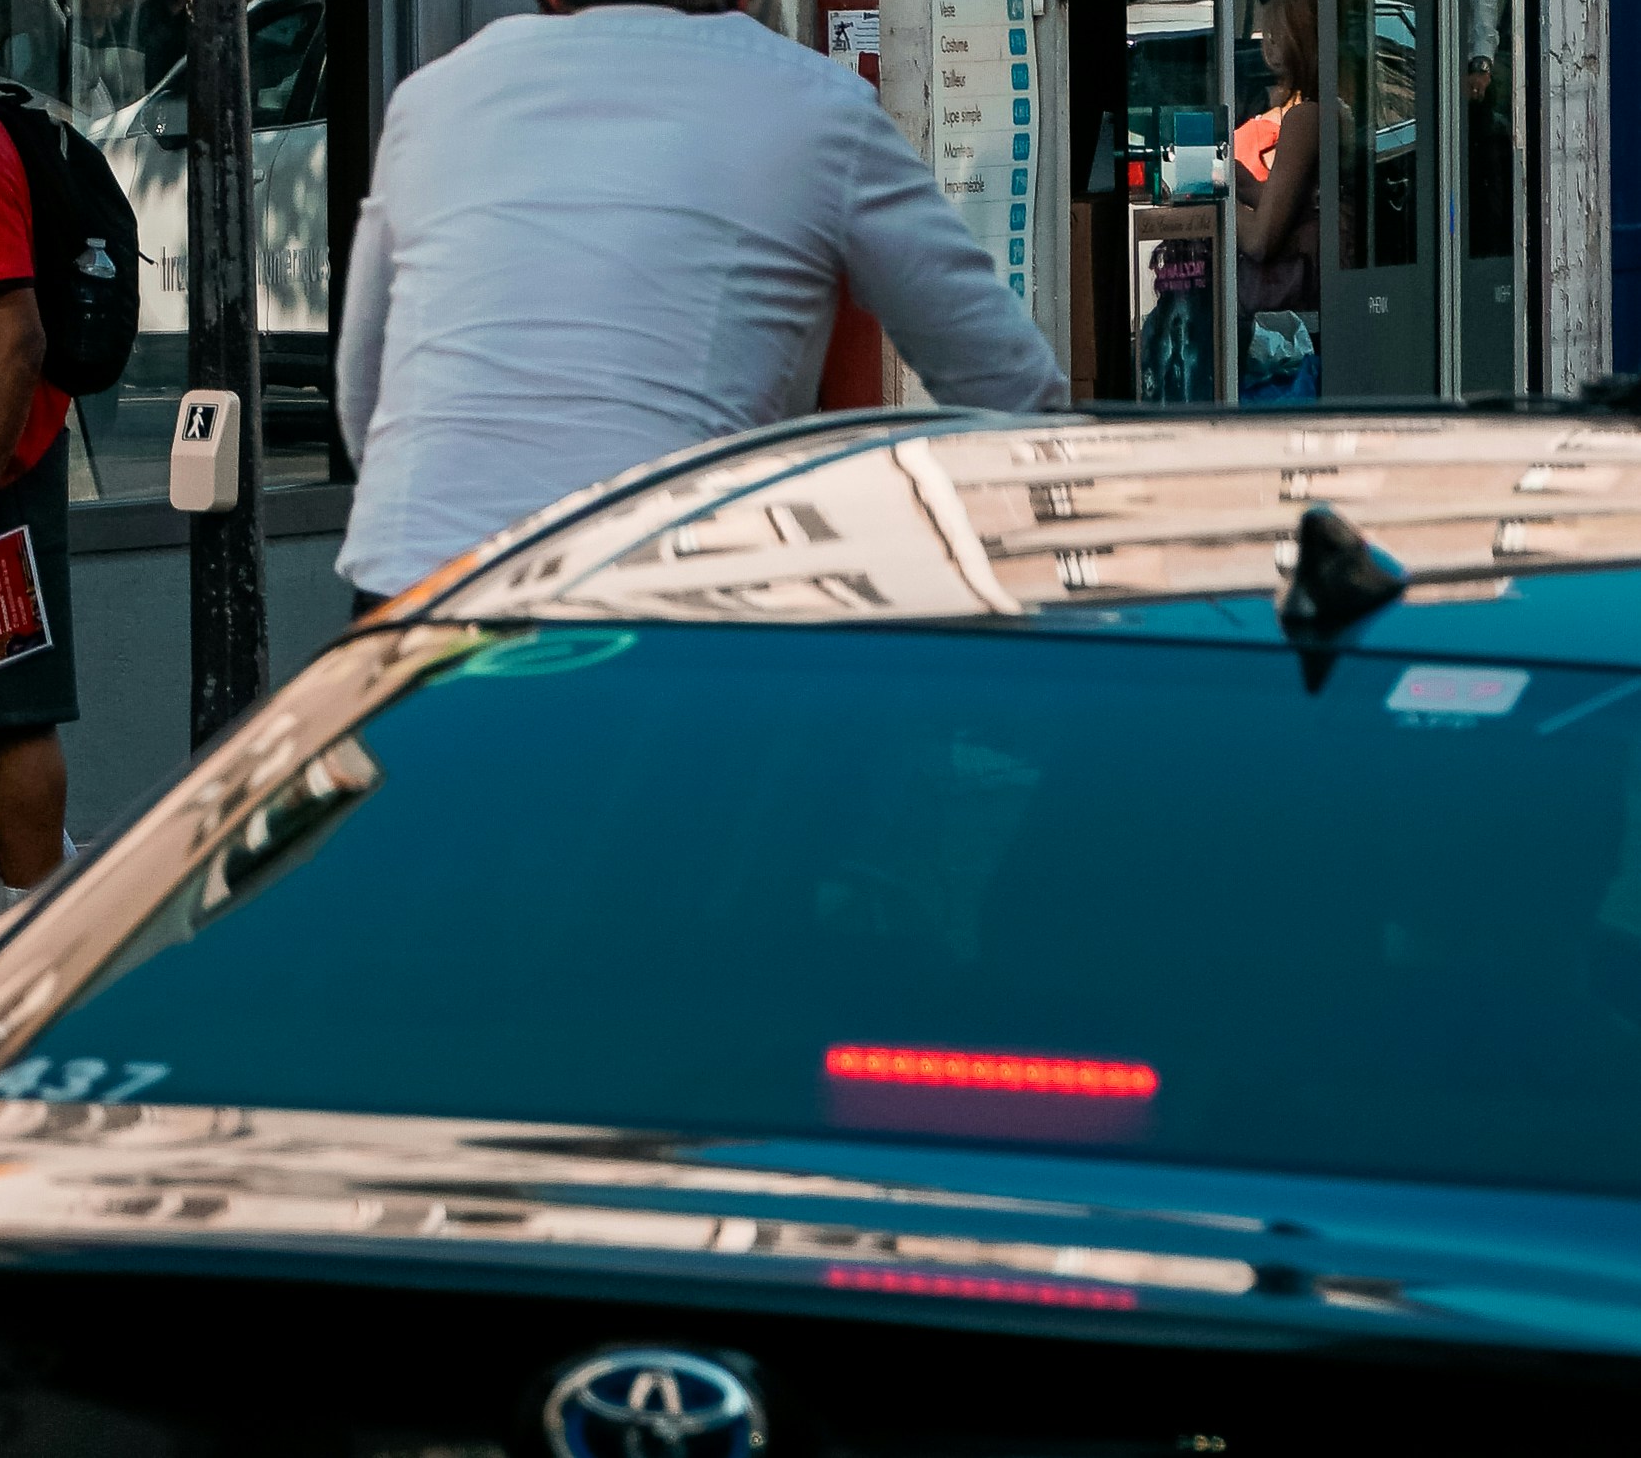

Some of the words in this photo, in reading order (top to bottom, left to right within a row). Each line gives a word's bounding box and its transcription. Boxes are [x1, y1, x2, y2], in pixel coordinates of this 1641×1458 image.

[941, 35, 969, 53] Costume
[943, 106, 960, 128] Jupe
[961, 103, 982, 126] simple
